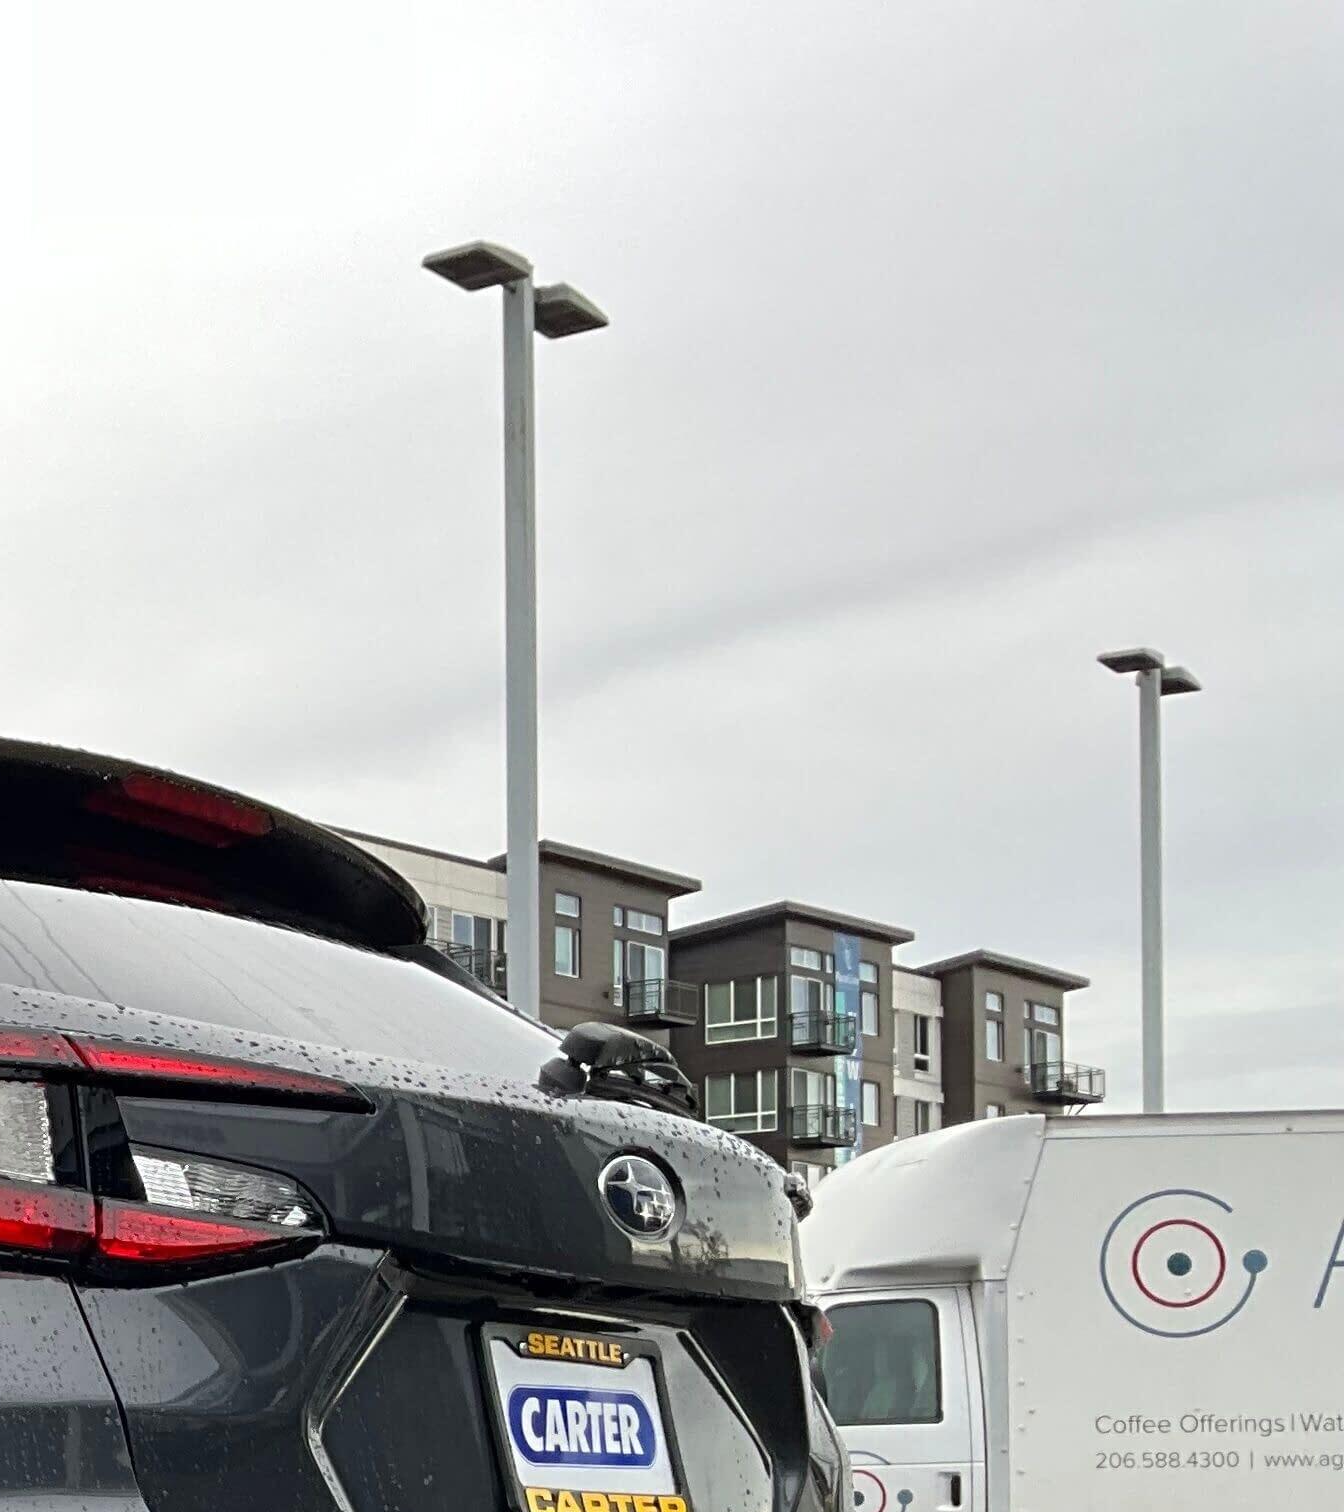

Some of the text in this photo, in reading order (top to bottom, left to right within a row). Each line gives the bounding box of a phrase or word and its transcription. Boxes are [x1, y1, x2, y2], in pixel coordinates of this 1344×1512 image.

[526, 1331, 624, 1364] SEATTLE
[520, 1396, 645, 1456] CARTER
[1094, 1414, 1172, 1434] Coffee
[1179, 1414, 1286, 1438] Offerings
[1095, 1451, 1241, 1470] 206.588.4300
